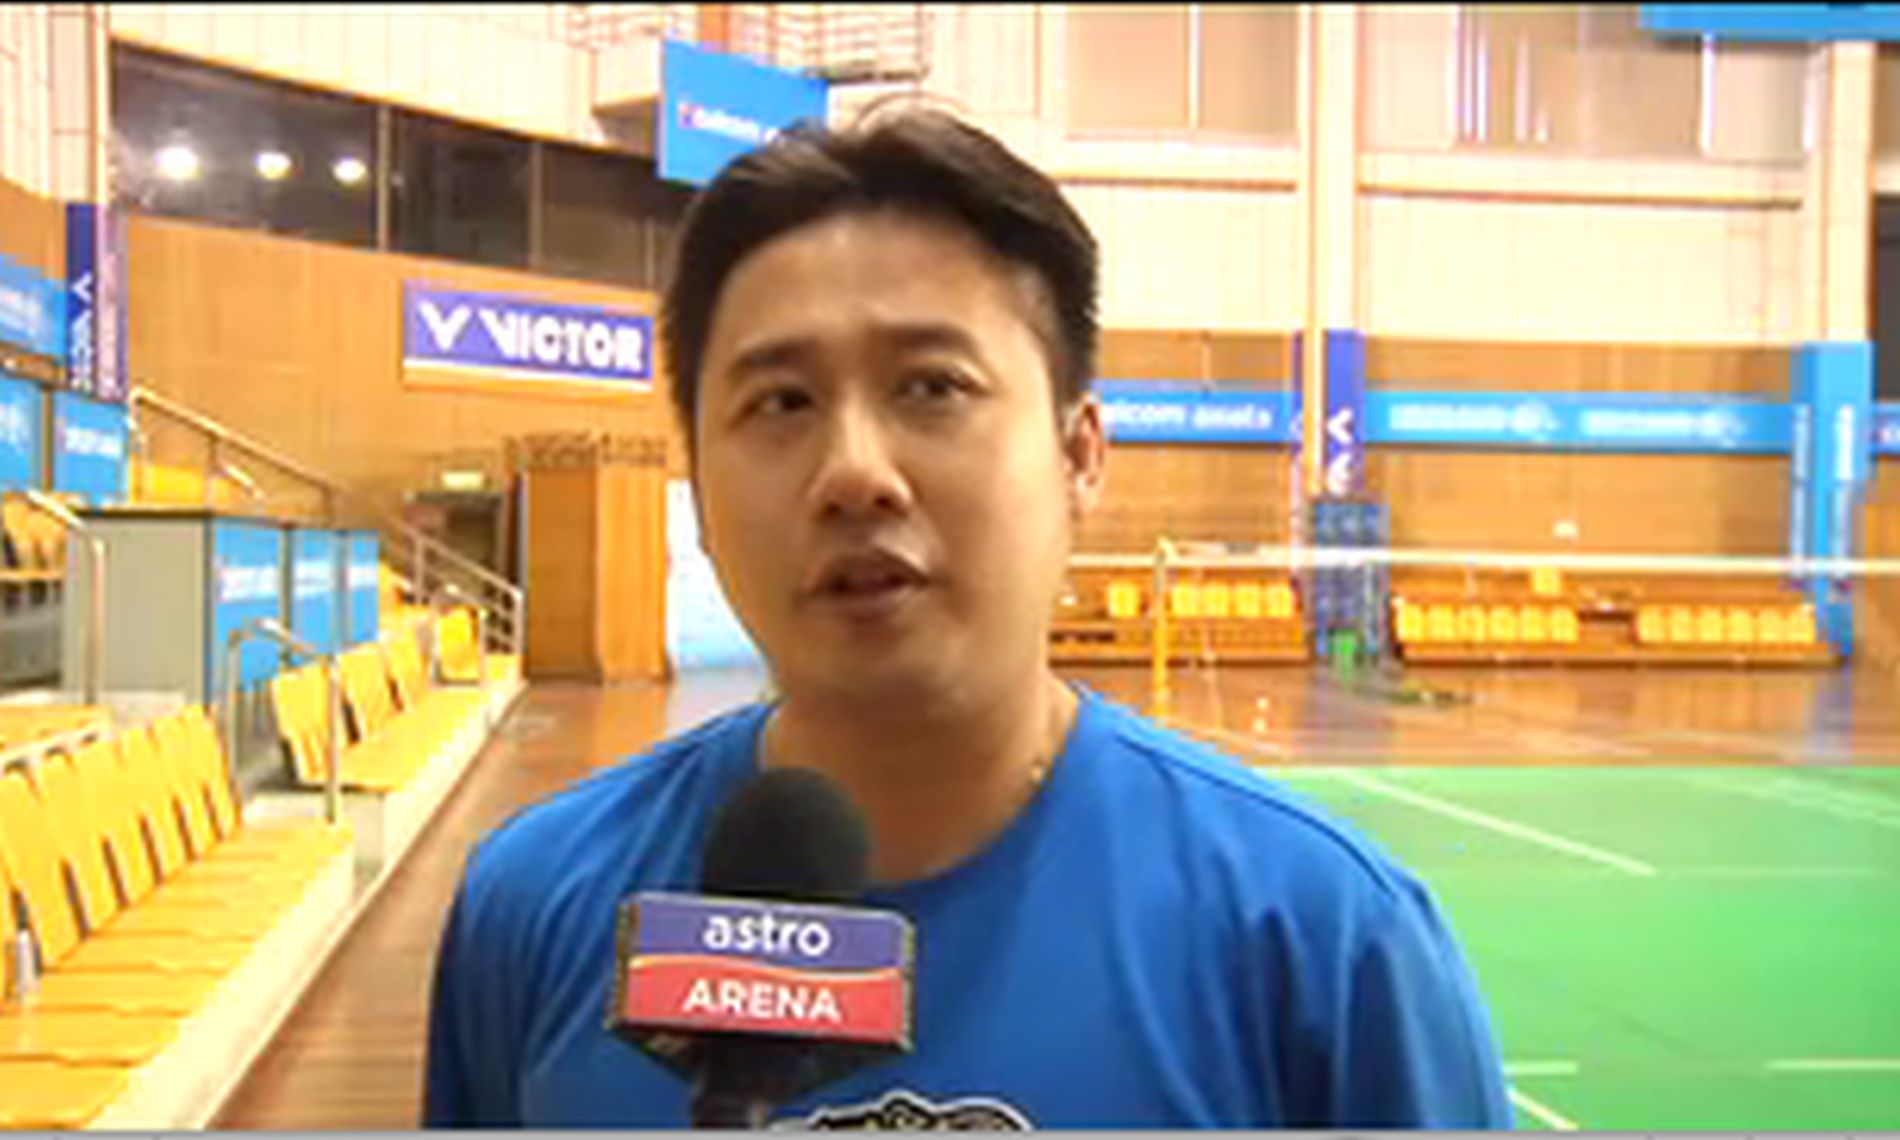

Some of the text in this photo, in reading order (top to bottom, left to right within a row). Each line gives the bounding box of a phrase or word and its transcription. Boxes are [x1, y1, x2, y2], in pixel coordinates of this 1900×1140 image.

[477, 307, 643, 373] VICTOR
[703, 913, 831, 956] astro
[682, 978, 842, 1024] ARENA
